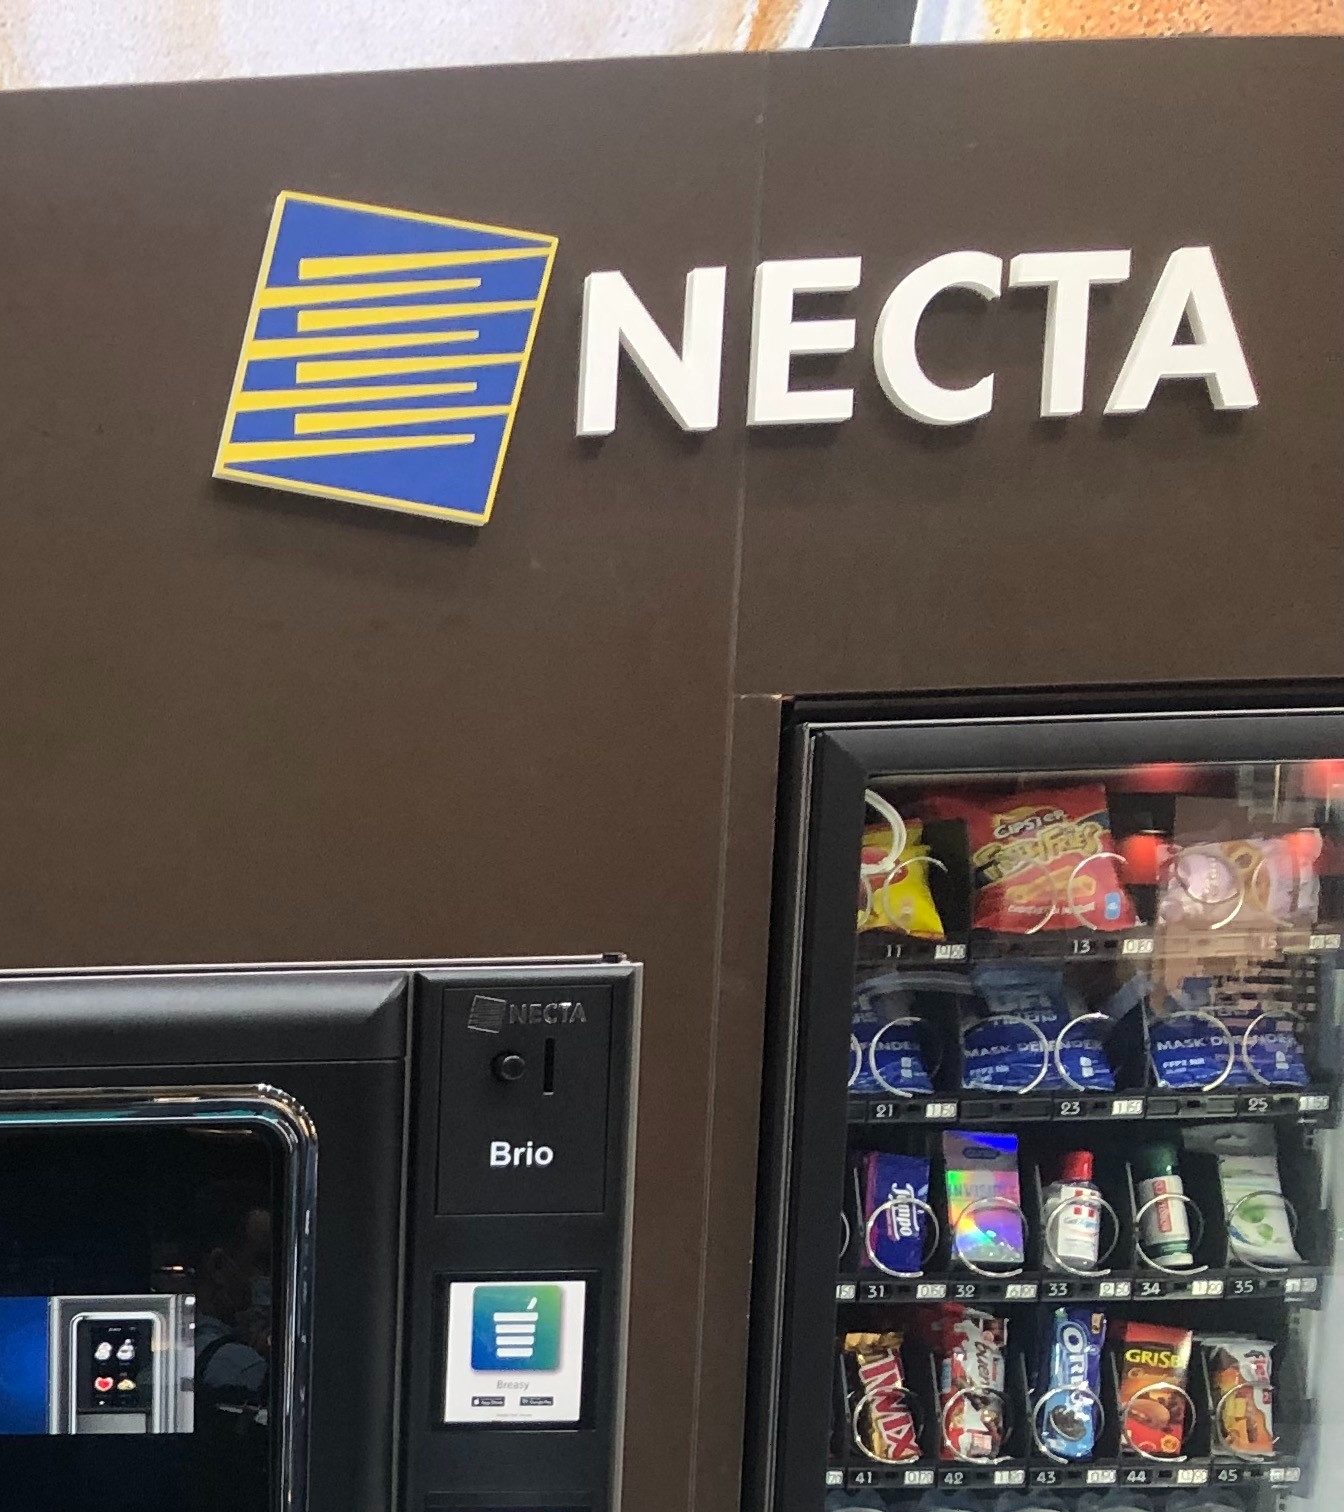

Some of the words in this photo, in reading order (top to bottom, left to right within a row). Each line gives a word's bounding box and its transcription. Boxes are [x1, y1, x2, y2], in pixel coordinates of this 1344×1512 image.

[576, 246, 1259, 437] NECTA
[886, 944, 902, 958] 11
[1072, 940, 1091, 954] 13
[508, 1001, 587, 1025] NECTA
[875, 1104, 894, 1118] 21
[1060, 1101, 1081, 1115] 23
[1248, 1097, 1268, 1112] 25
[489, 1140, 555, 1167] Brio
[867, 1284, 886, 1298] 31
[955, 1284, 976, 1298] 32
[1048, 1282, 1068, 1296] 33
[1141, 1281, 1161, 1295] 34
[1234, 1280, 1254, 1294] 35
[1125, 1348, 1183, 1369] GRISB
[496, 1380, 530, 1392] Breasy
[858, 1347, 922, 1460] TWIX
[855, 1471, 873, 1484] 41
[943, 1472, 964, 1485] 42
[1036, 1471, 1056, 1484] 43
[1126, 1470, 1147, 1483] 44
[1217, 1468, 1238, 1482] 45
